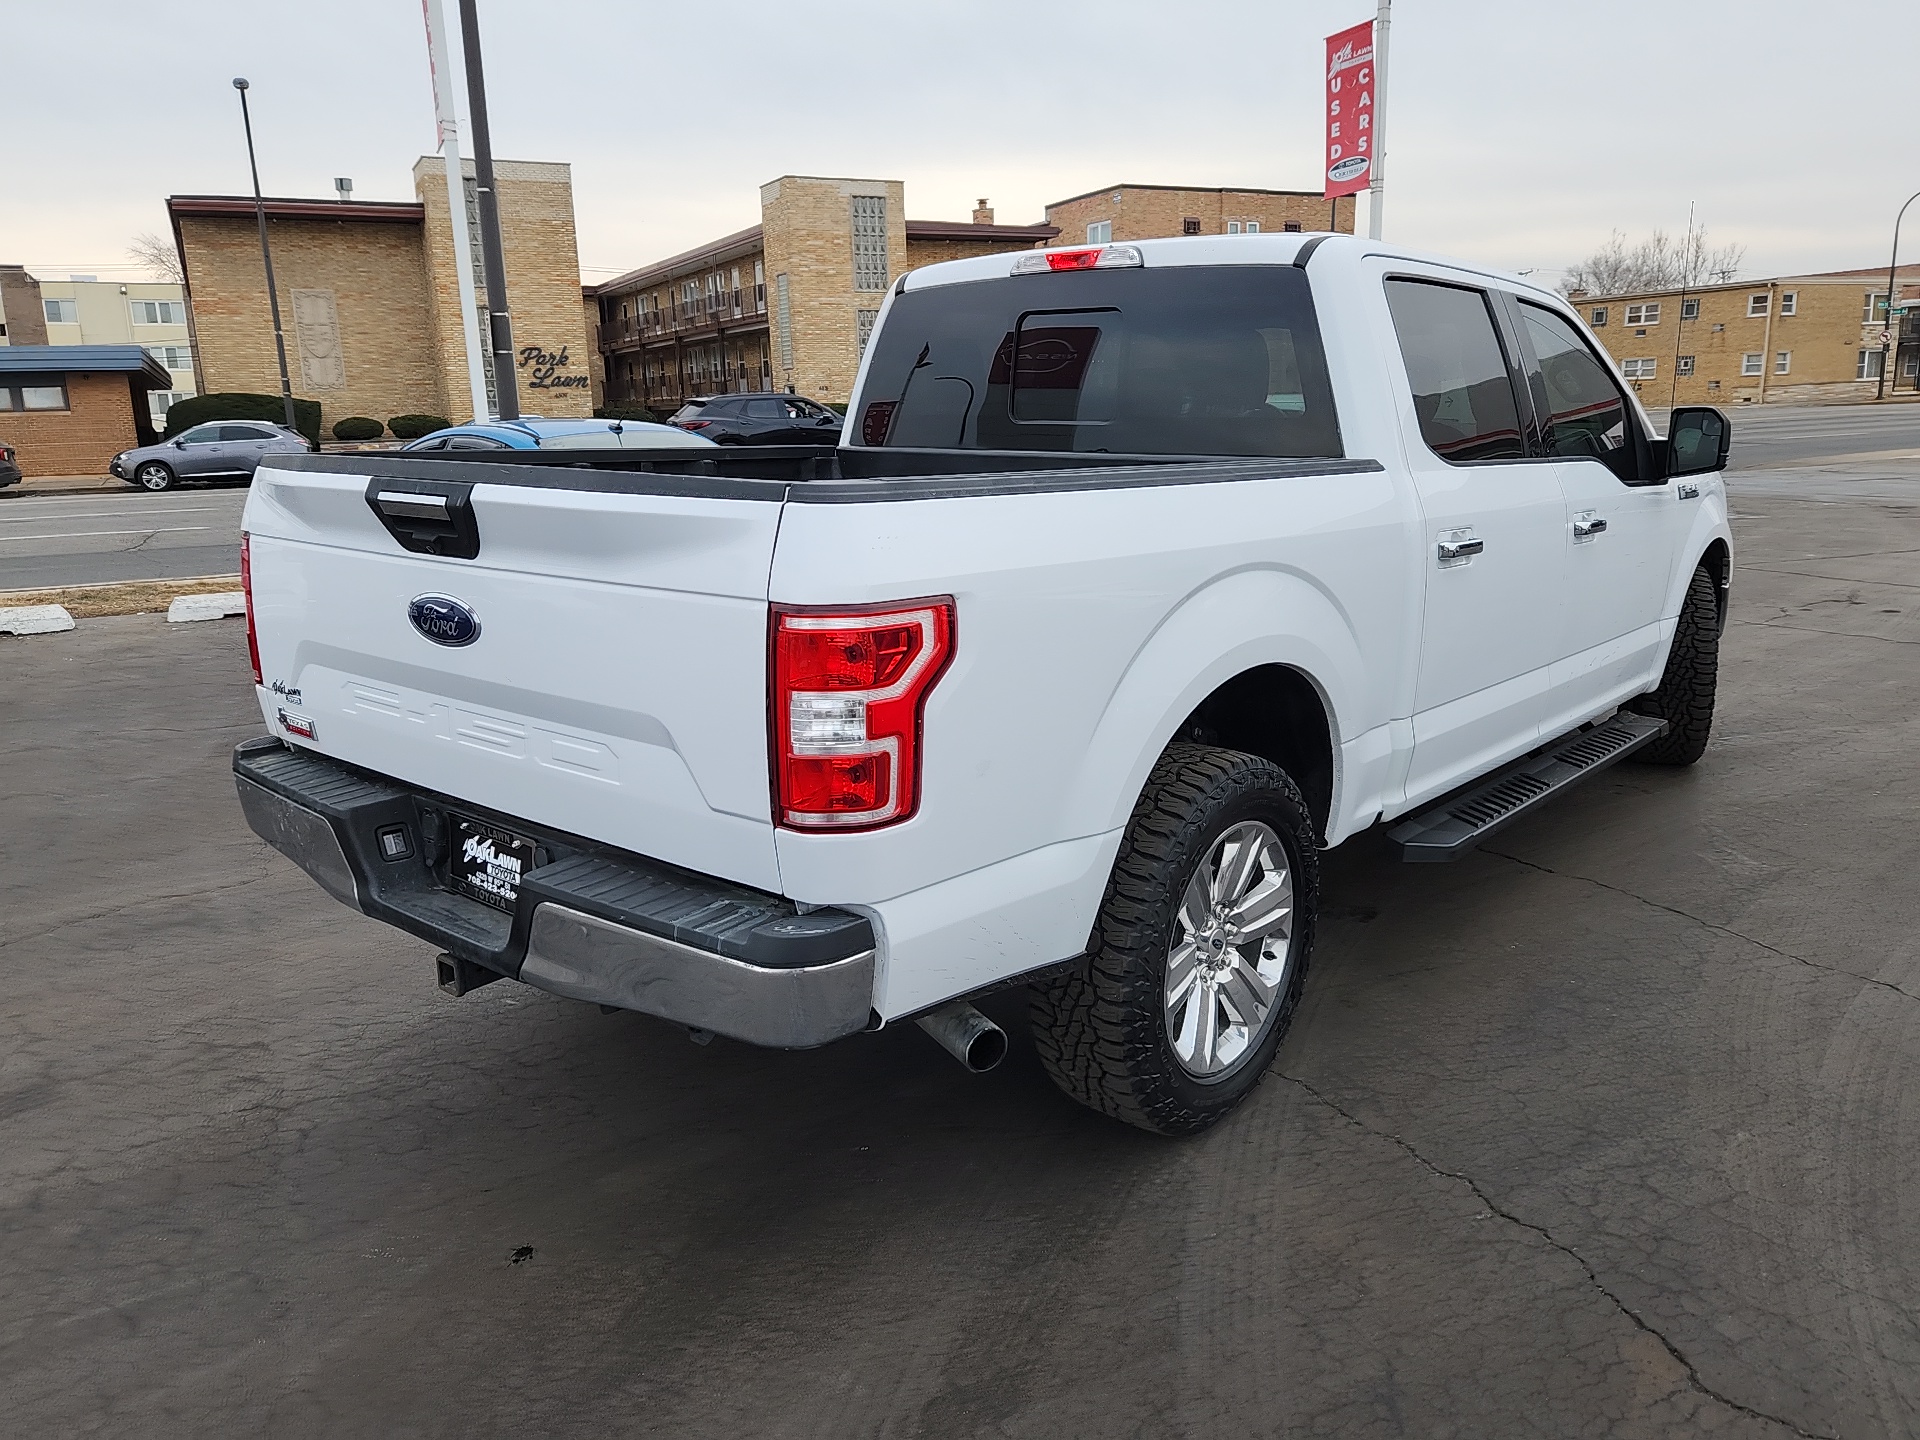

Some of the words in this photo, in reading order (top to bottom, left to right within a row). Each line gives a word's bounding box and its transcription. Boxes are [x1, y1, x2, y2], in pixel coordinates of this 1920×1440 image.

[1331, 77, 1342, 160] USED
[1358, 67, 1371, 152] CARS
[519, 345, 569, 367] Park
[529, 367, 589, 389] Lawn
[421, 604, 459, 636] Ford
[288, 718, 308, 729] TEXAS
[341, 680, 621, 786] F-150
[487, 827, 511, 844] LAWN
[490, 864, 517, 884] TOYOTA
[474, 887, 506, 909] TOYOTA
